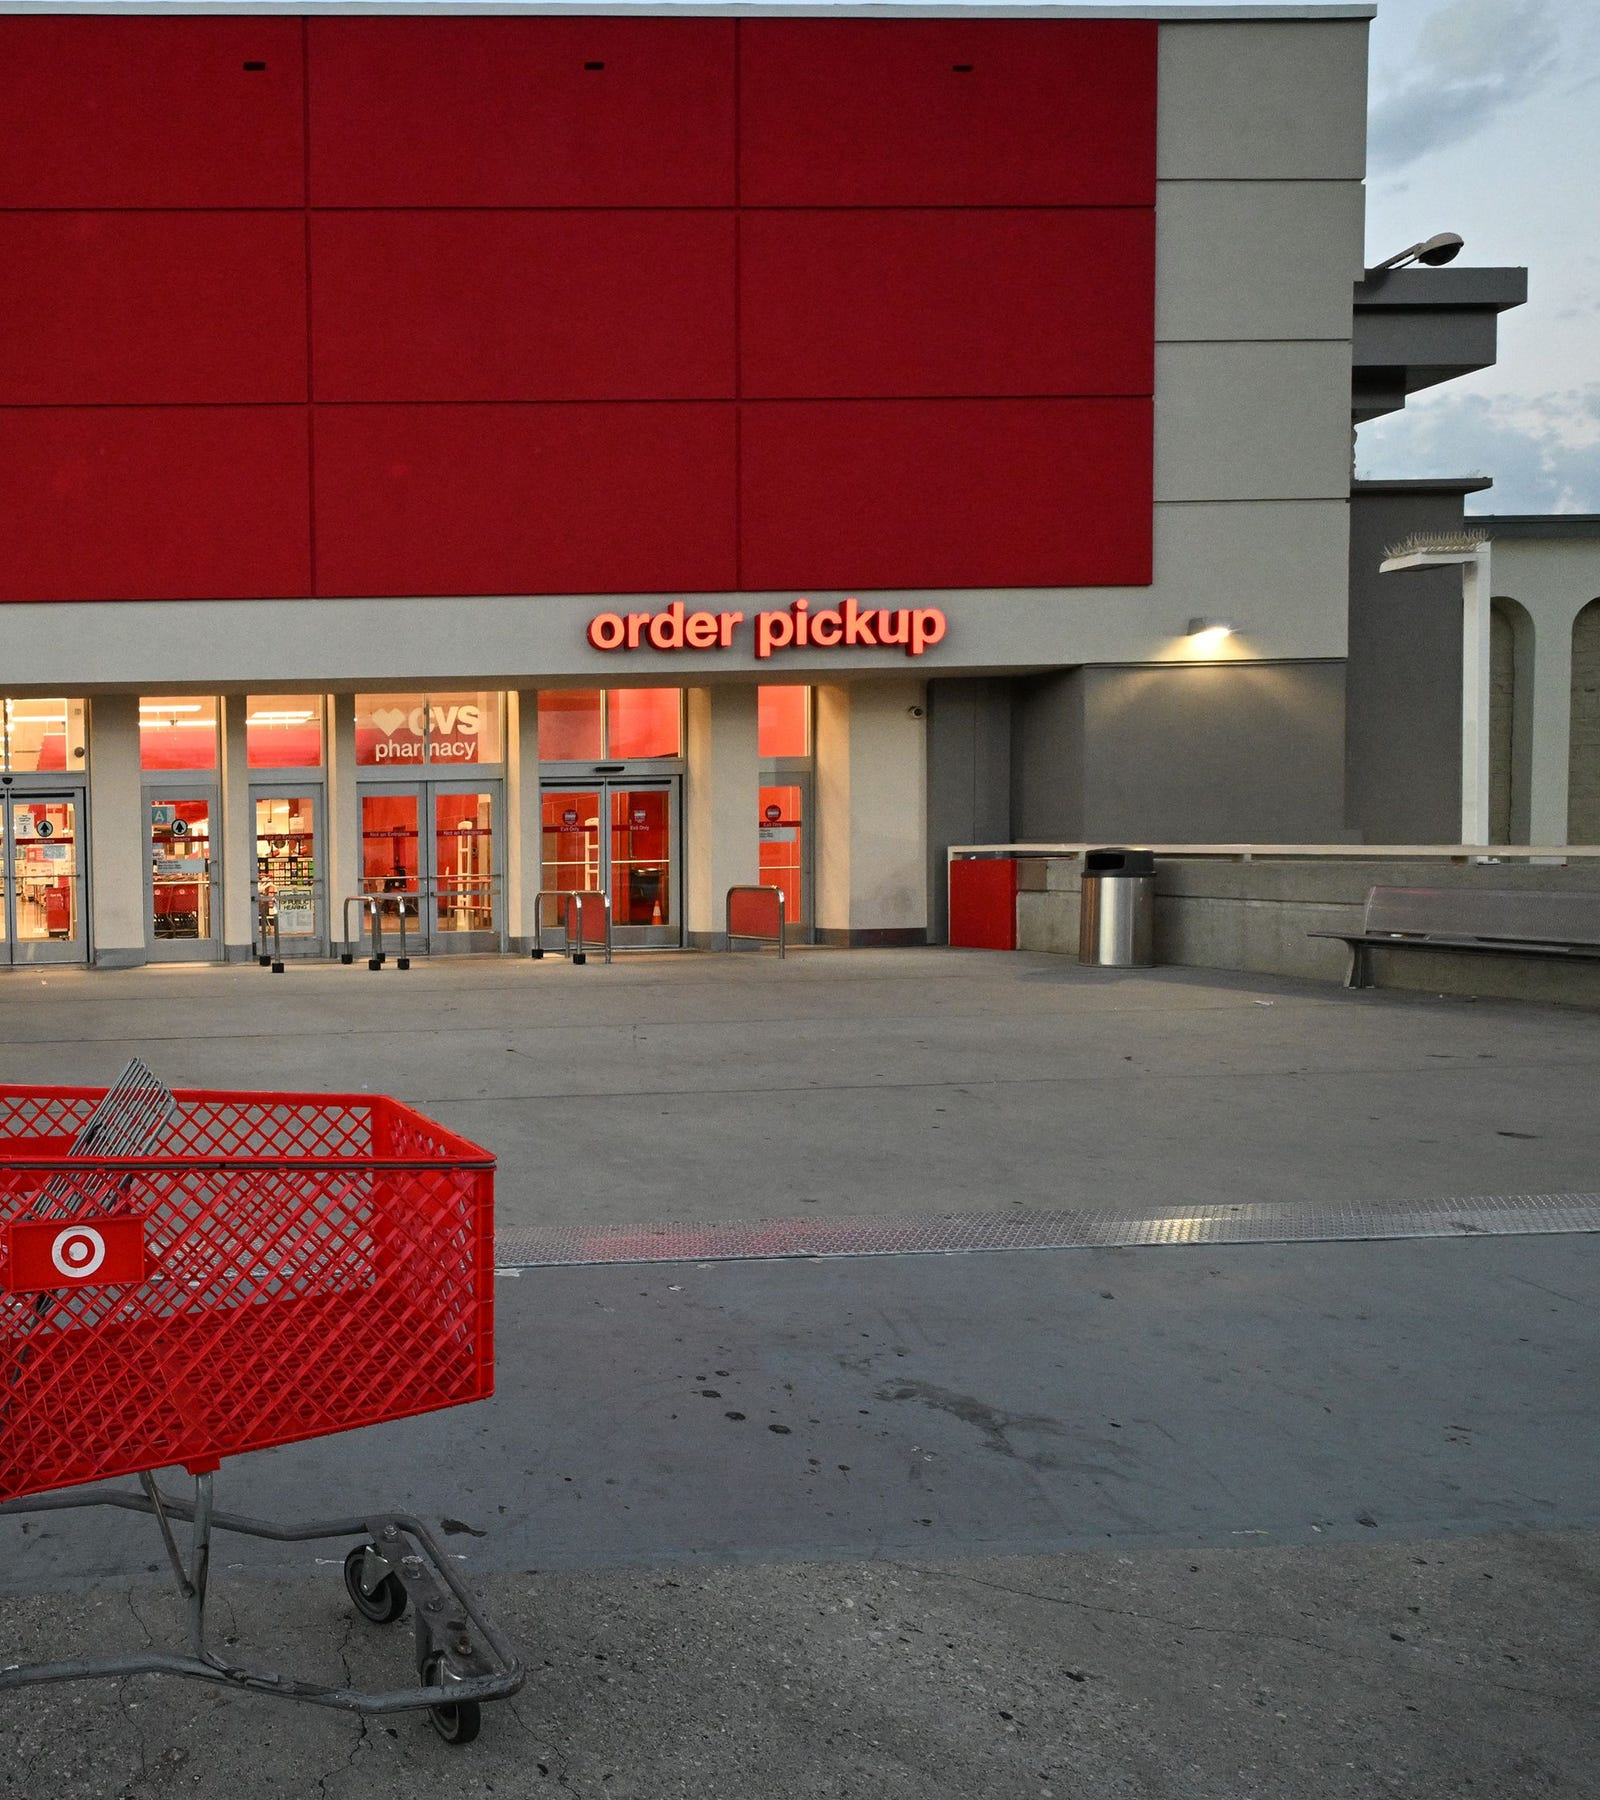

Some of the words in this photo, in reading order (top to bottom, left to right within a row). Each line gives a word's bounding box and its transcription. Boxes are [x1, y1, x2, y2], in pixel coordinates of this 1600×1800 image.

[587, 601, 744, 650] order
[755, 598, 947, 659] pickup
[407, 705, 481, 737] CVS
[154, 810, 164, 822] A
